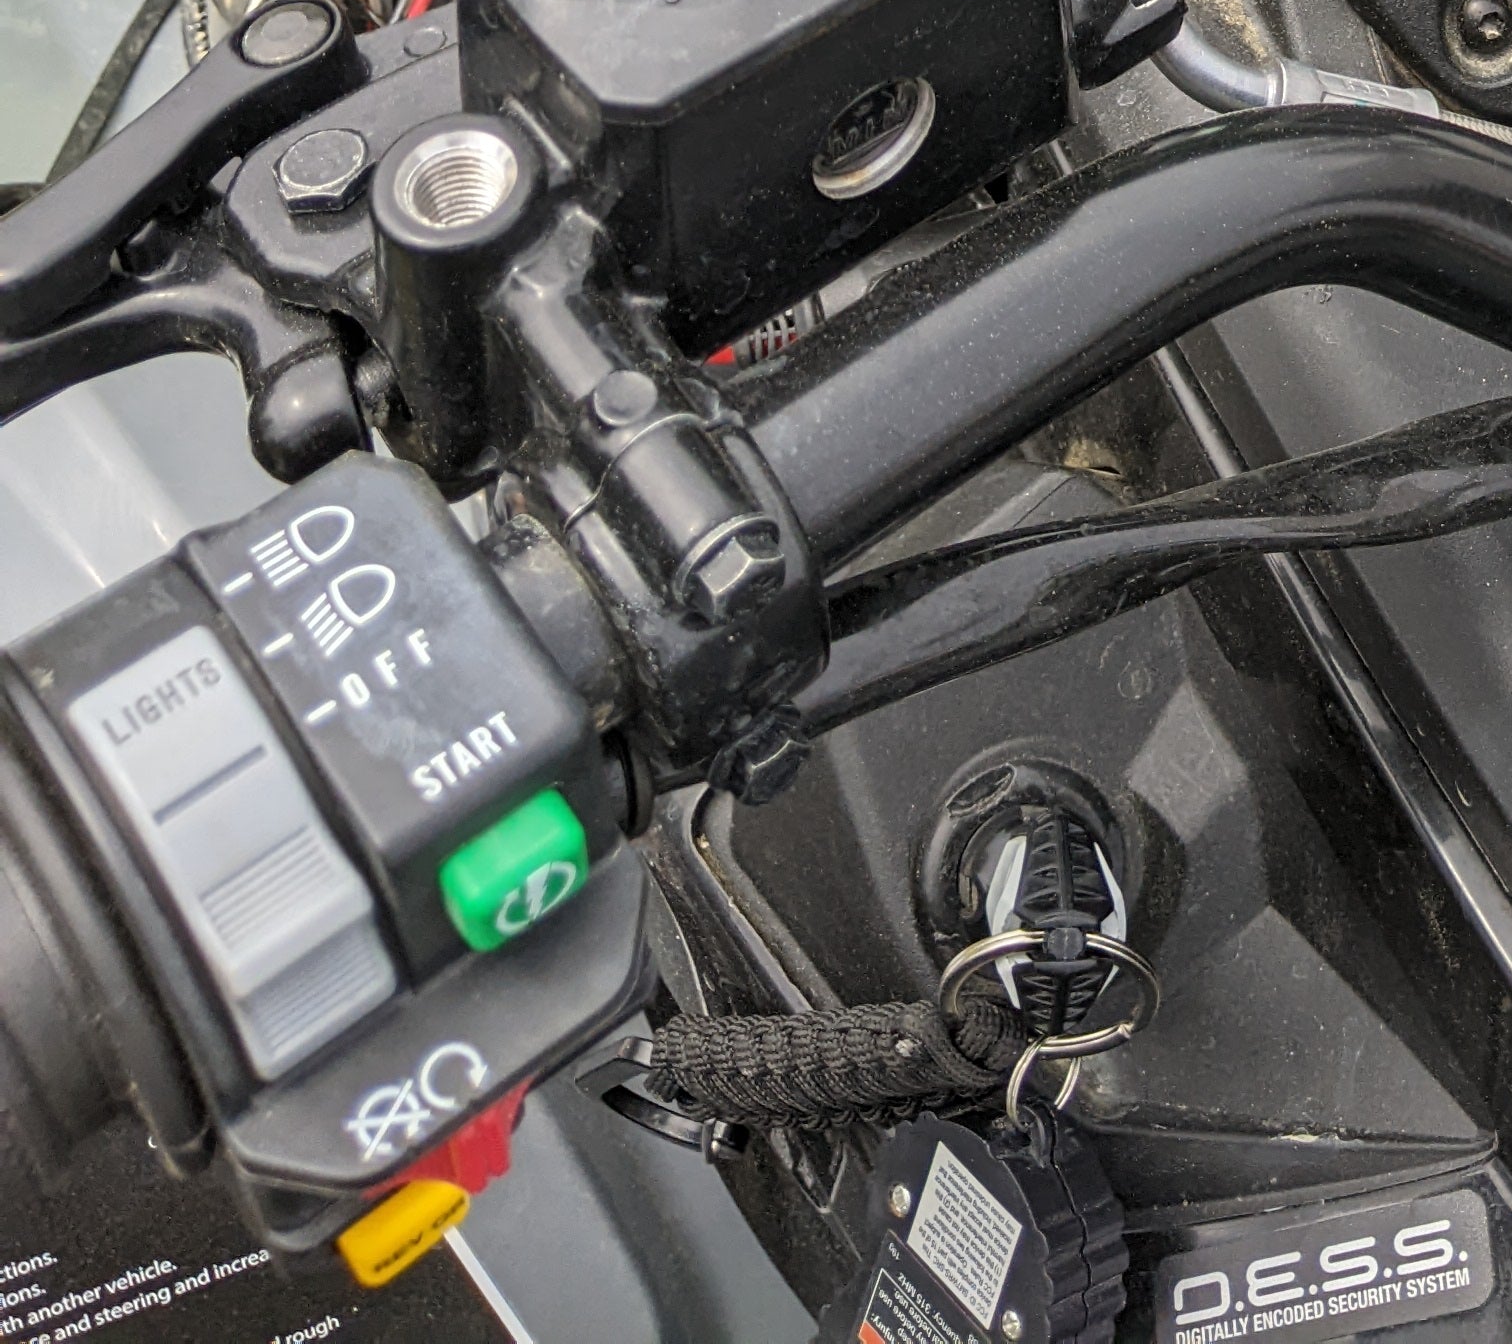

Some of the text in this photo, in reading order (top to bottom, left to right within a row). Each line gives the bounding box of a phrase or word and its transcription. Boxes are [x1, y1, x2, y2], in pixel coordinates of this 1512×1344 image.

[102, 657, 224, 748] LIGHTS
[341, 627, 434, 708] OFF
[410, 711, 519, 802] START
[27, 1286, 102, 1326] another
[104, 1258, 178, 1296] vehicle.
[54, 1313, 92, 1341] and
[95, 1286, 171, 1327] steering
[174, 1268, 211, 1296] and
[892, 1305, 916, 1336] before
[908, 1306, 933, 1338] before
[915, 1292, 931, 1315] 315
[1175, 1267, 1471, 1344] DIGITALLY ENCODED SECURITY SYSTEM
